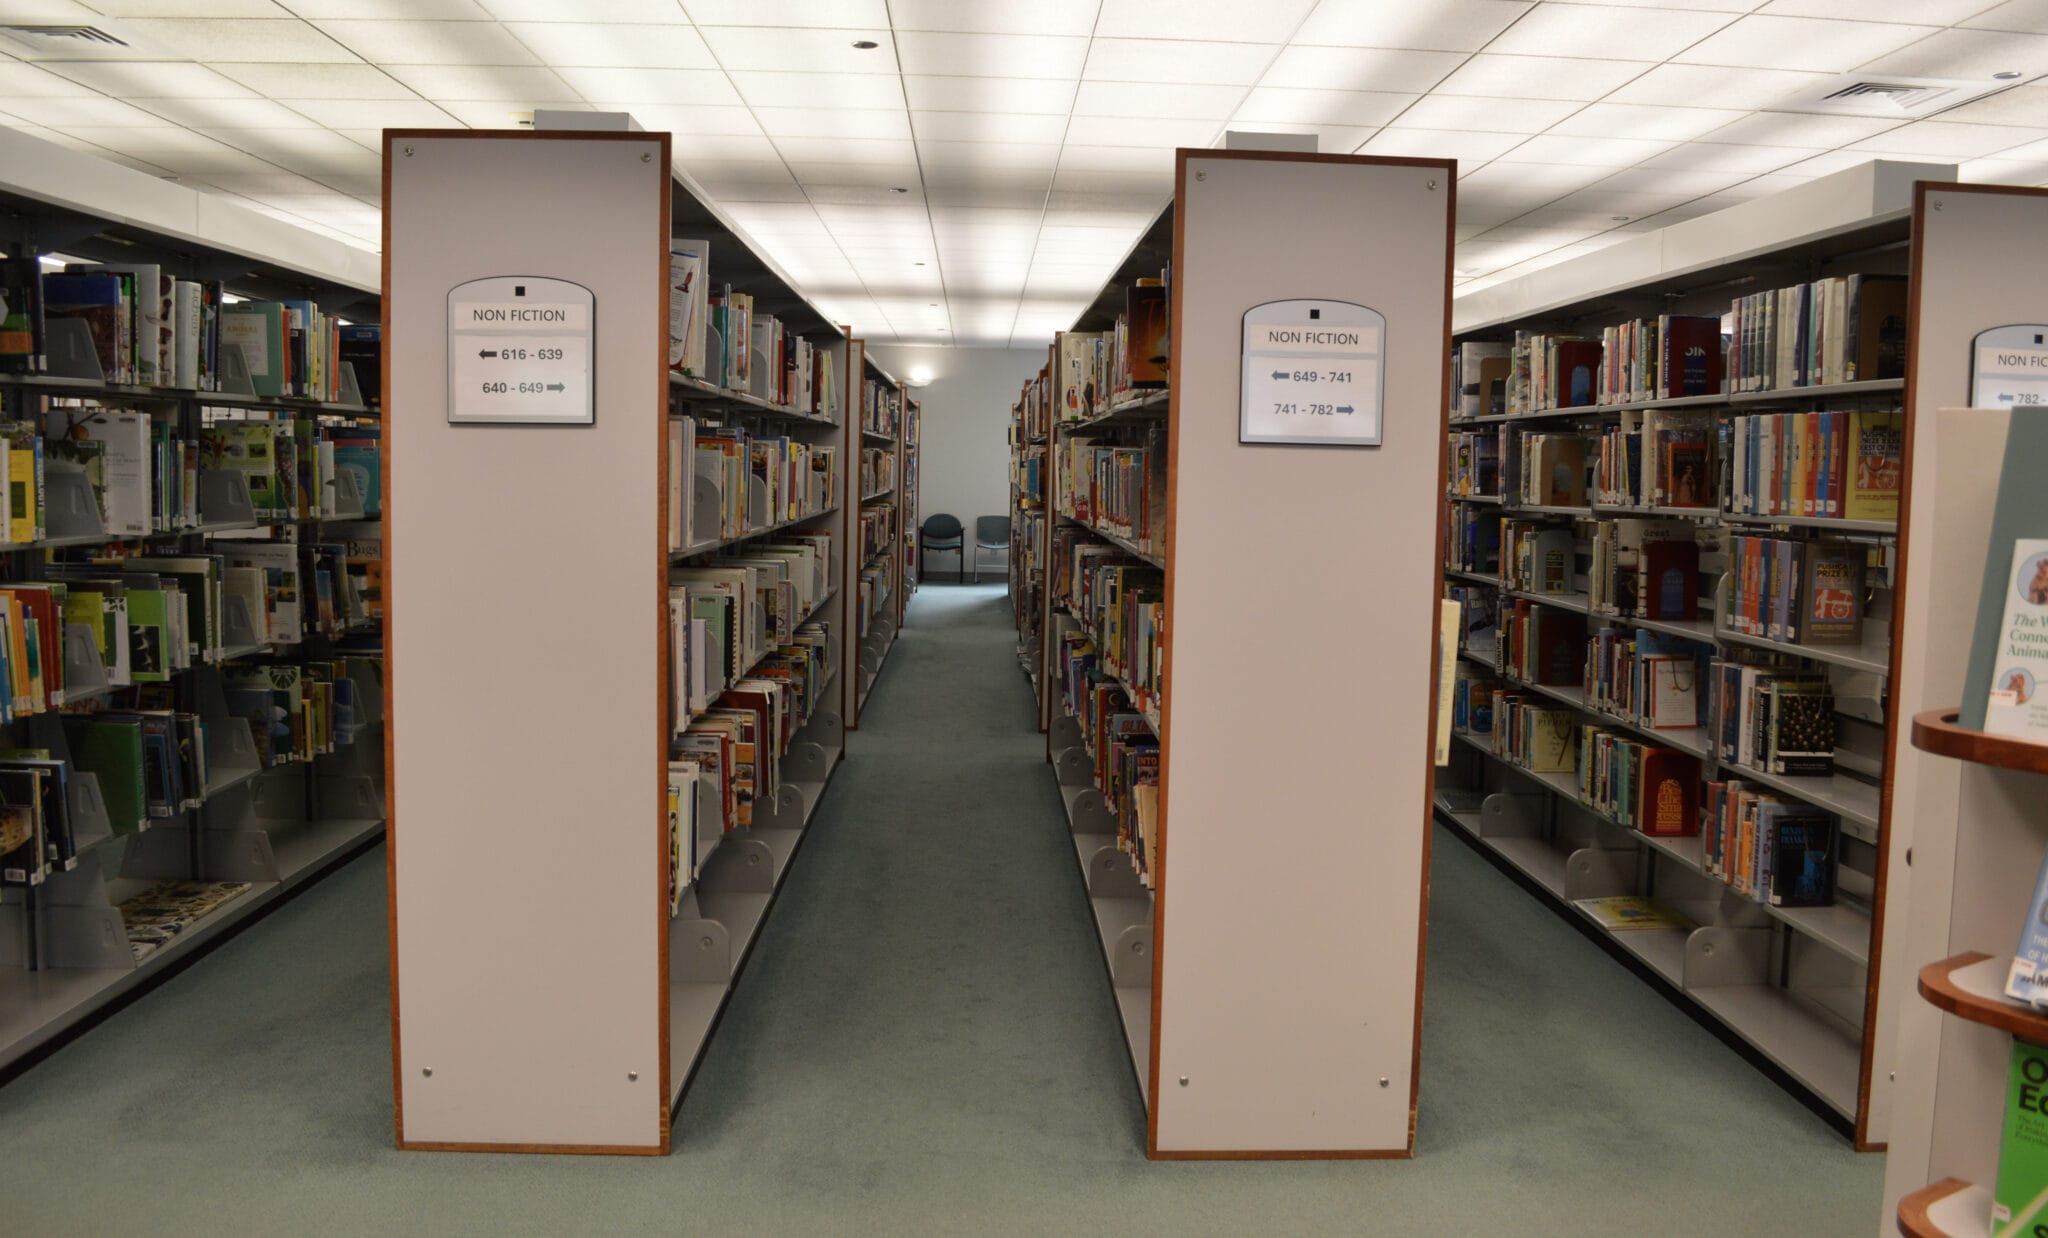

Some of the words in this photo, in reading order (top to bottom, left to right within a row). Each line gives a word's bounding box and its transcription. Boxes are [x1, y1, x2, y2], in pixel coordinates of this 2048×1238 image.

[473, 309, 506, 321] NON
[510, 309, 566, 321] FICTION
[1268, 330, 1301, 344] NON
[1305, 331, 1359, 345] FICTION
[501, 348, 527, 360] 616
[538, 348, 563, 360] 639
[1997, 354, 2027, 367] NON
[1293, 370, 1318, 383] 649
[1328, 371, 1352, 383] 741
[482, 382, 507, 394] 640
[518, 382, 544, 394] 649
[2017, 393, 2040, 405] 782
[1274, 403, 1298, 415] 741
[1309, 404, 1334, 416] 782
[345, 540, 378, 558] Bugs
[2014, 613, 2038, 627] The
